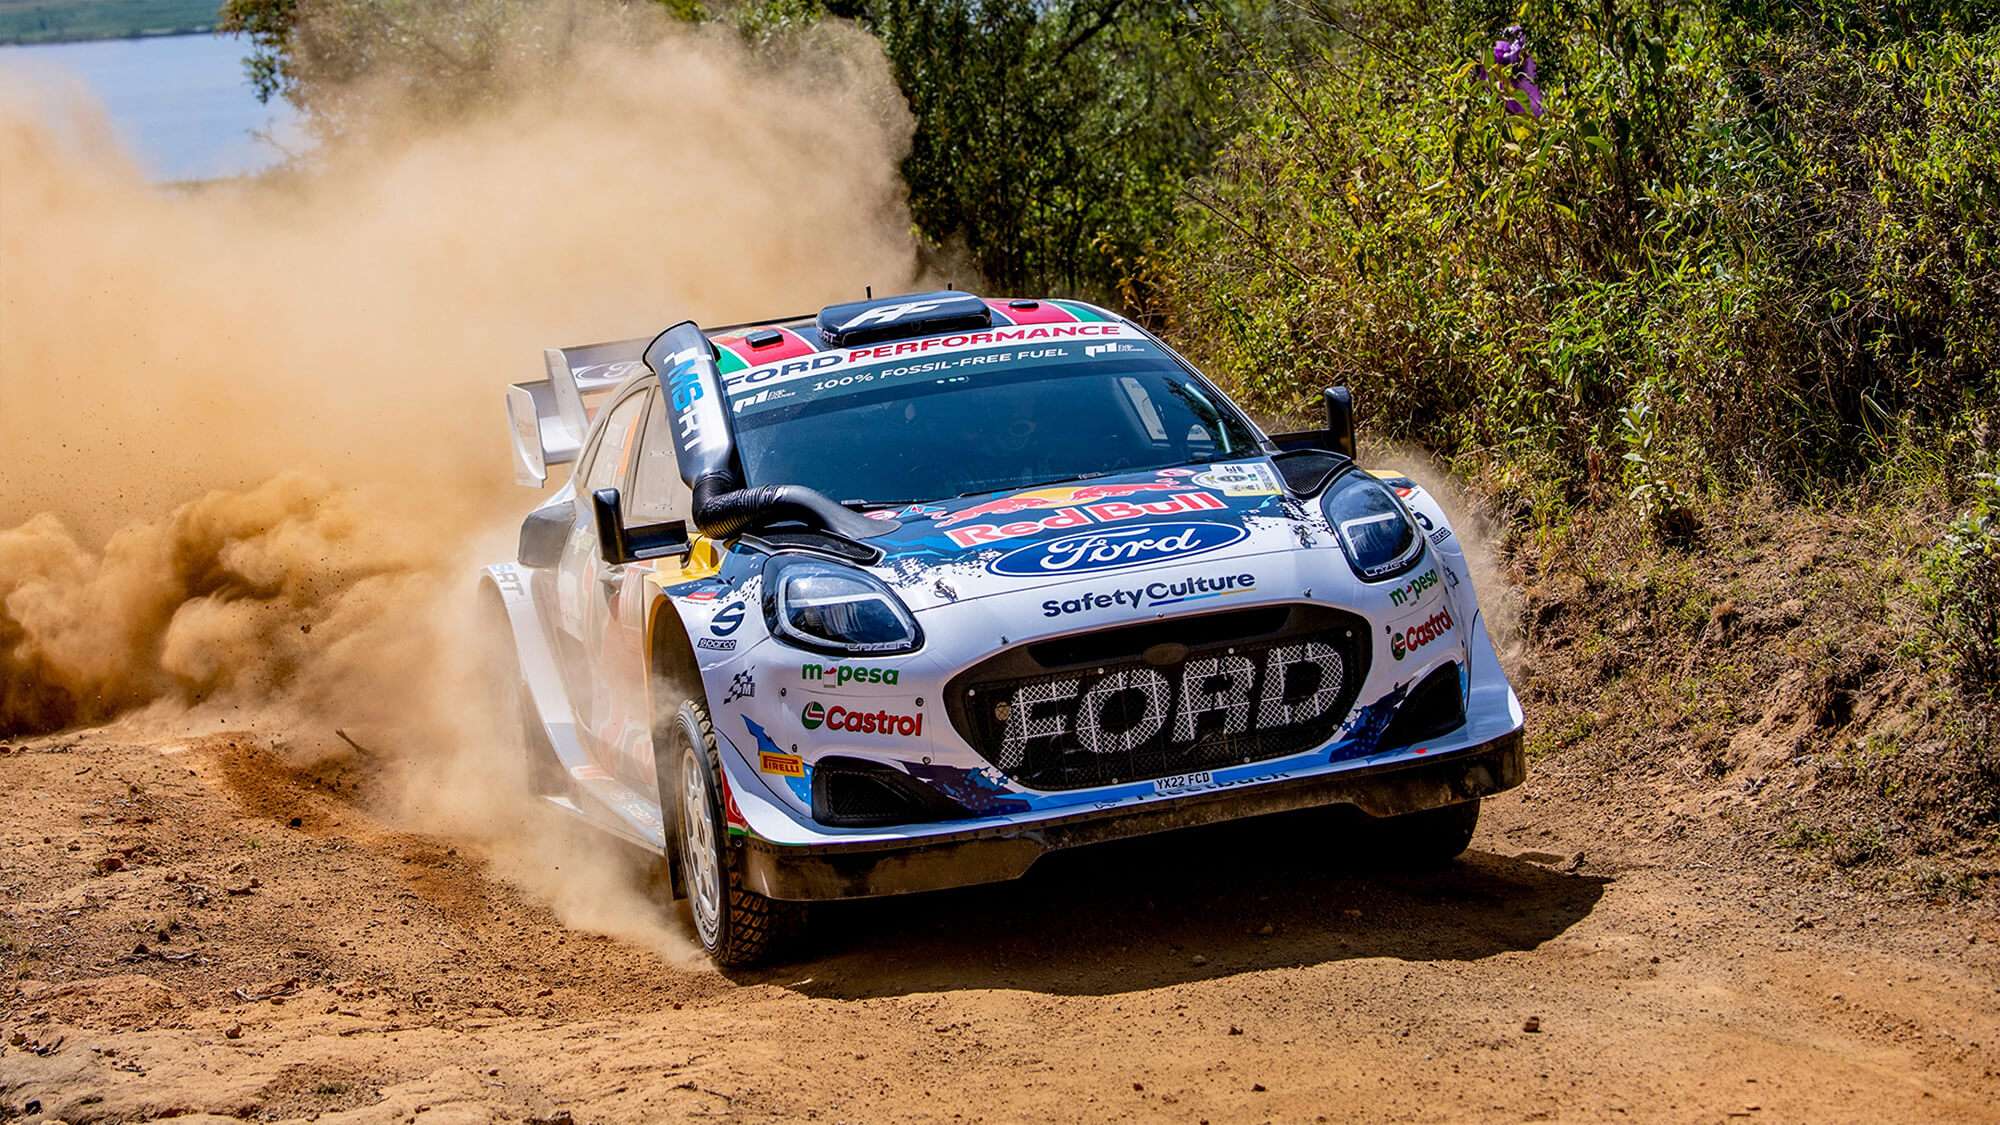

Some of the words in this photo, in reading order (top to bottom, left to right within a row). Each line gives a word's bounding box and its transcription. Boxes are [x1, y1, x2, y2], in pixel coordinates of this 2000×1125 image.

[726, 354, 843, 390] FORD
[848, 326, 1121, 363] PERFORMANCE
[812, 372, 874, 392] 100%
[880, 353, 1012, 380] FOSSIL-FREE
[1017, 348, 1069, 361] FUEL
[945, 504, 1087, 548] Red
[1086, 492, 1229, 523] Bull
[1040, 528, 1201, 571] Ford
[1042, 571, 1256, 618] SafetyCulture
[1405, 605, 1454, 652] Castrol
[825, 705, 923, 737] Castrol
[1000, 641, 1344, 770] FORD
[763, 755, 800, 773] PIRELLI
[1156, 775, 1185, 790] YX22
[1189, 772, 1210, 787] FCD
